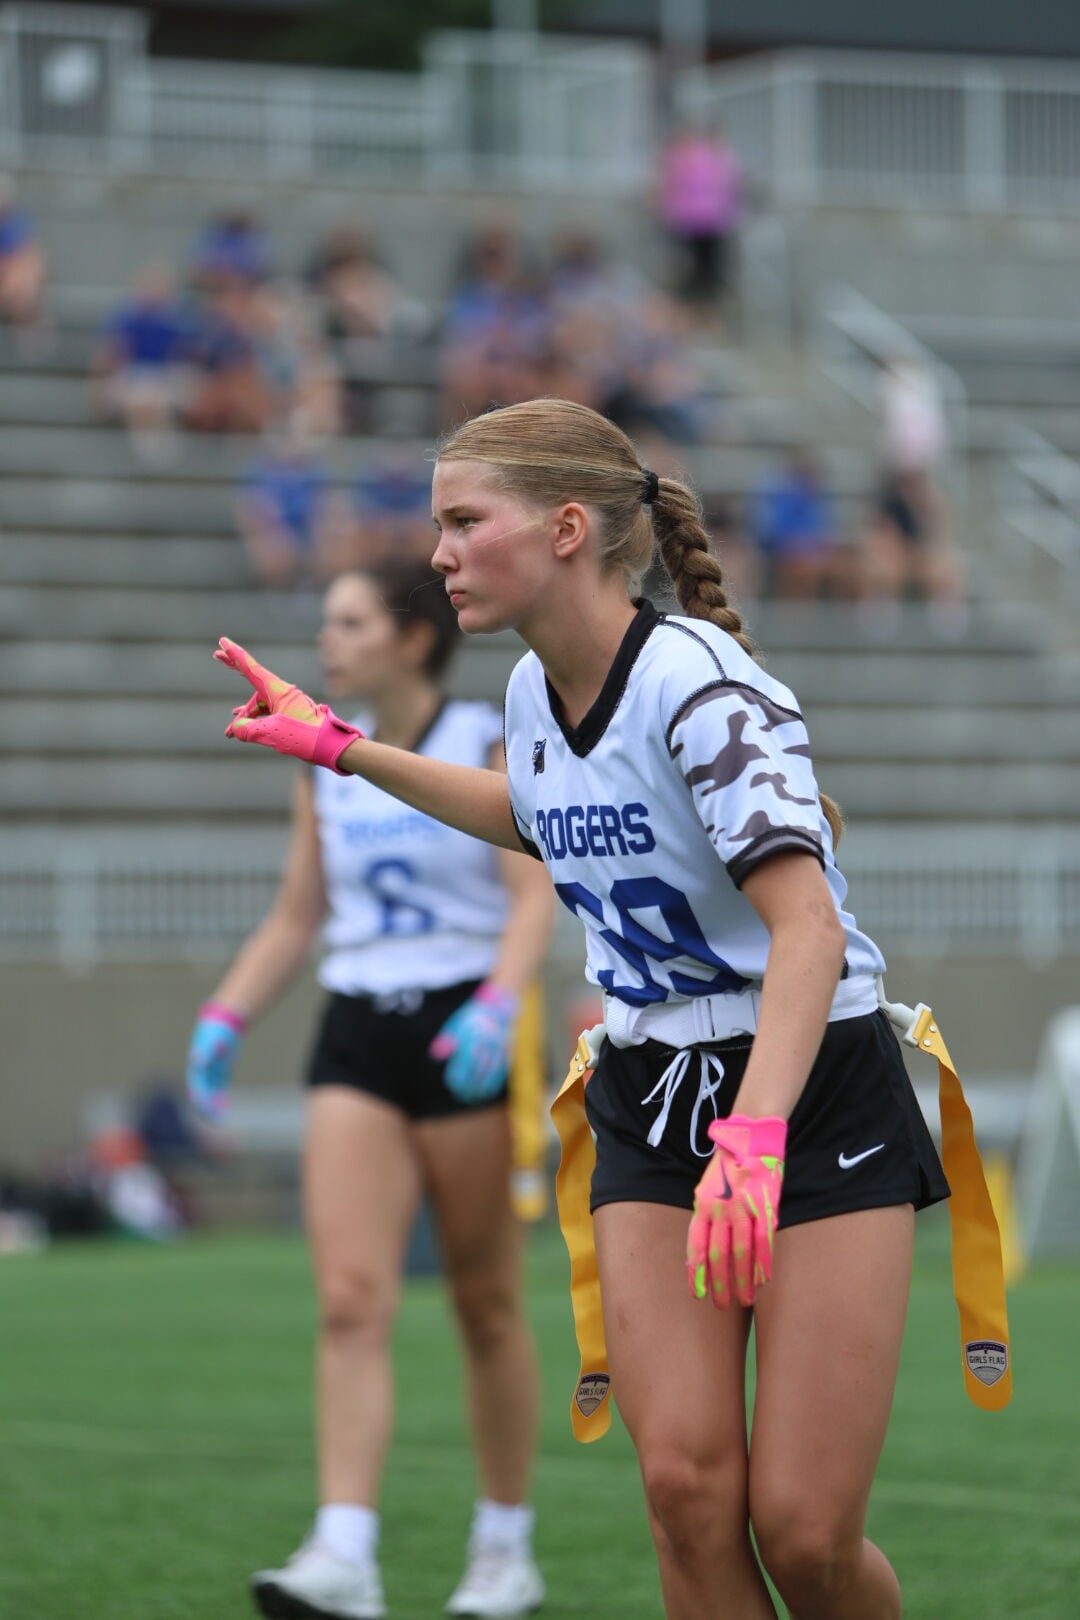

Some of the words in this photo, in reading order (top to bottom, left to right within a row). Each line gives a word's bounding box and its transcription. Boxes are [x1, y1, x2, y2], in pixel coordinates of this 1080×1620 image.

[536, 802, 656, 860] ROGERS
[969, 1355, 987, 1364] GIRLS
[989, 1355, 1005, 1365] FLAG
